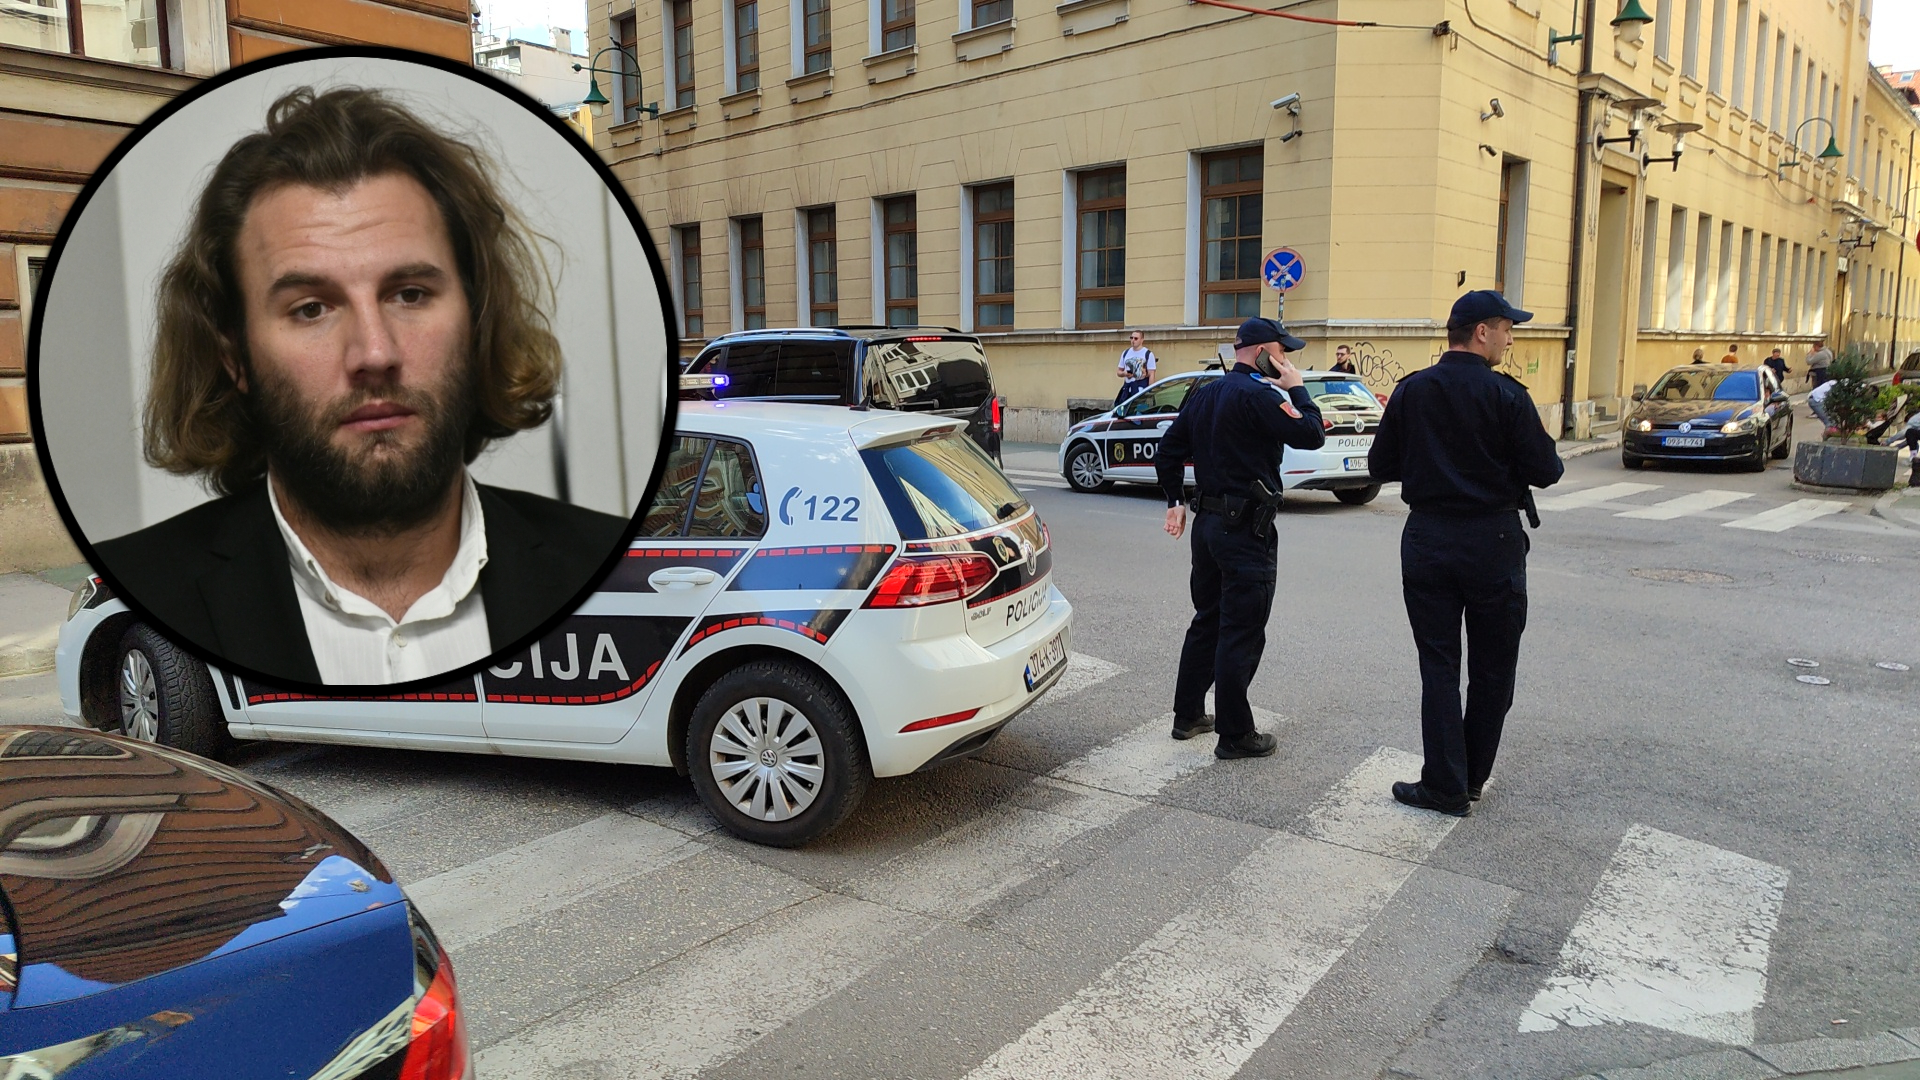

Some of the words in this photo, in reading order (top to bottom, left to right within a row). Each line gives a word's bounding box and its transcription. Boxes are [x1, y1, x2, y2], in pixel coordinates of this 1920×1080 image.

[804, 495, 861, 522] 122
[1006, 582, 1047, 626] POLICIJA
[1029, 635, 1062, 677] 374-K-397
